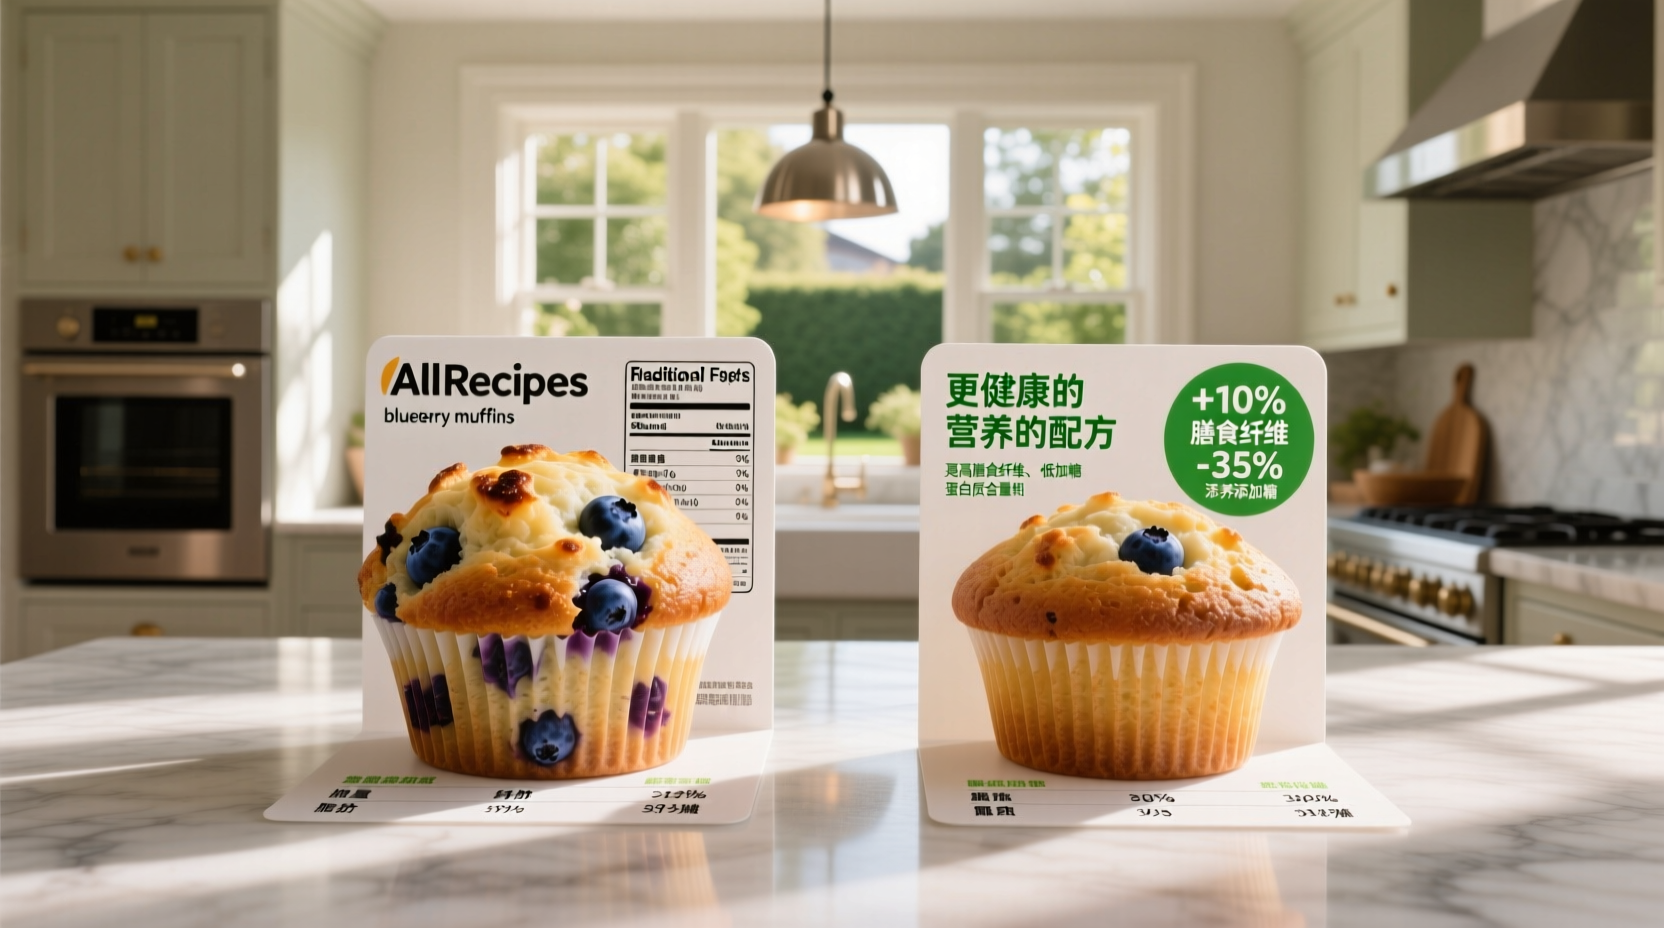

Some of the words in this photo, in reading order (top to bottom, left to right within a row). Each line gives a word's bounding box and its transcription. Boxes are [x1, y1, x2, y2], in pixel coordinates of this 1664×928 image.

[390, 362, 589, 405] AllRecipes
[946, 372, 1084, 408] 更健康的
[1192, 385, 1286, 415] +10%
[454, 407, 515, 425] muffins
[946, 413, 1117, 450] 营养的配方
[1190, 418, 1289, 446] 膳食纤维
[1197, 450, 1283, 480] -35%
